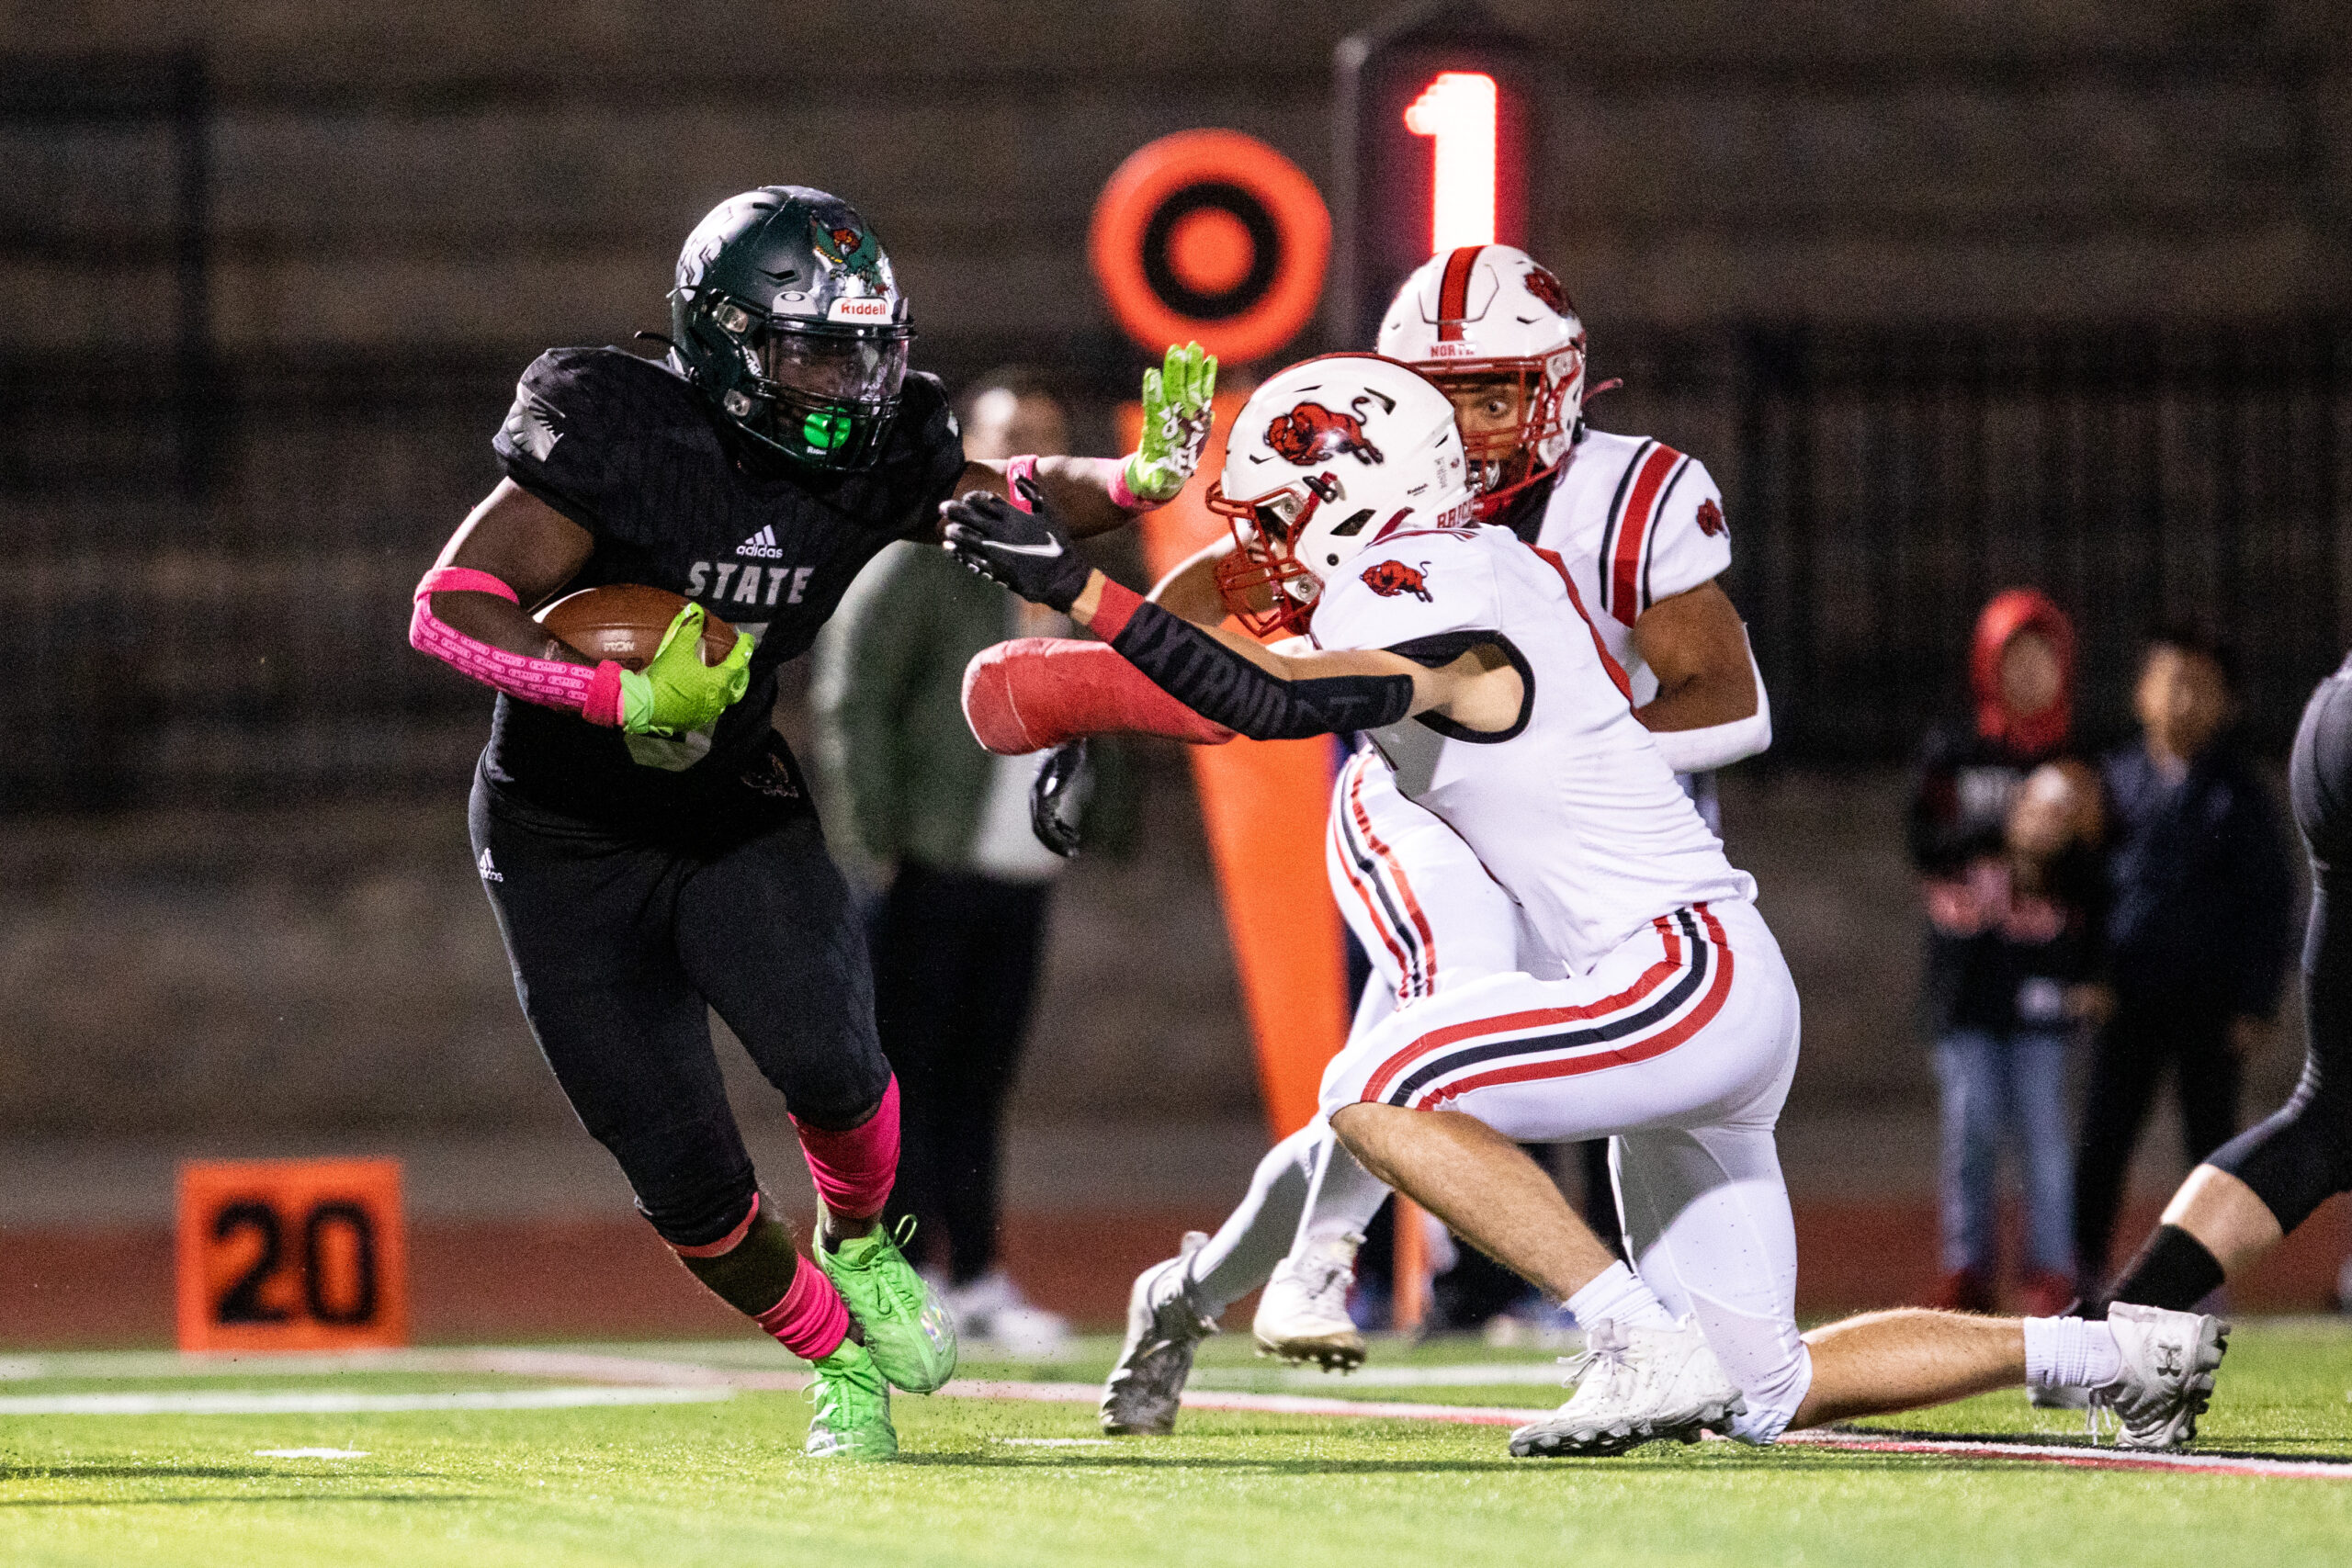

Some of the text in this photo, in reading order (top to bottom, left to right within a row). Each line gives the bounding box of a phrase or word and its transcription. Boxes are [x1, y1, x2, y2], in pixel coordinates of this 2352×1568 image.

[1404, 71, 1497, 252] 1
[842, 303, 886, 314] Riddell
[736, 544, 783, 558] adidas
[684, 561, 815, 605] STATE
[216, 1200, 379, 1324] 20
